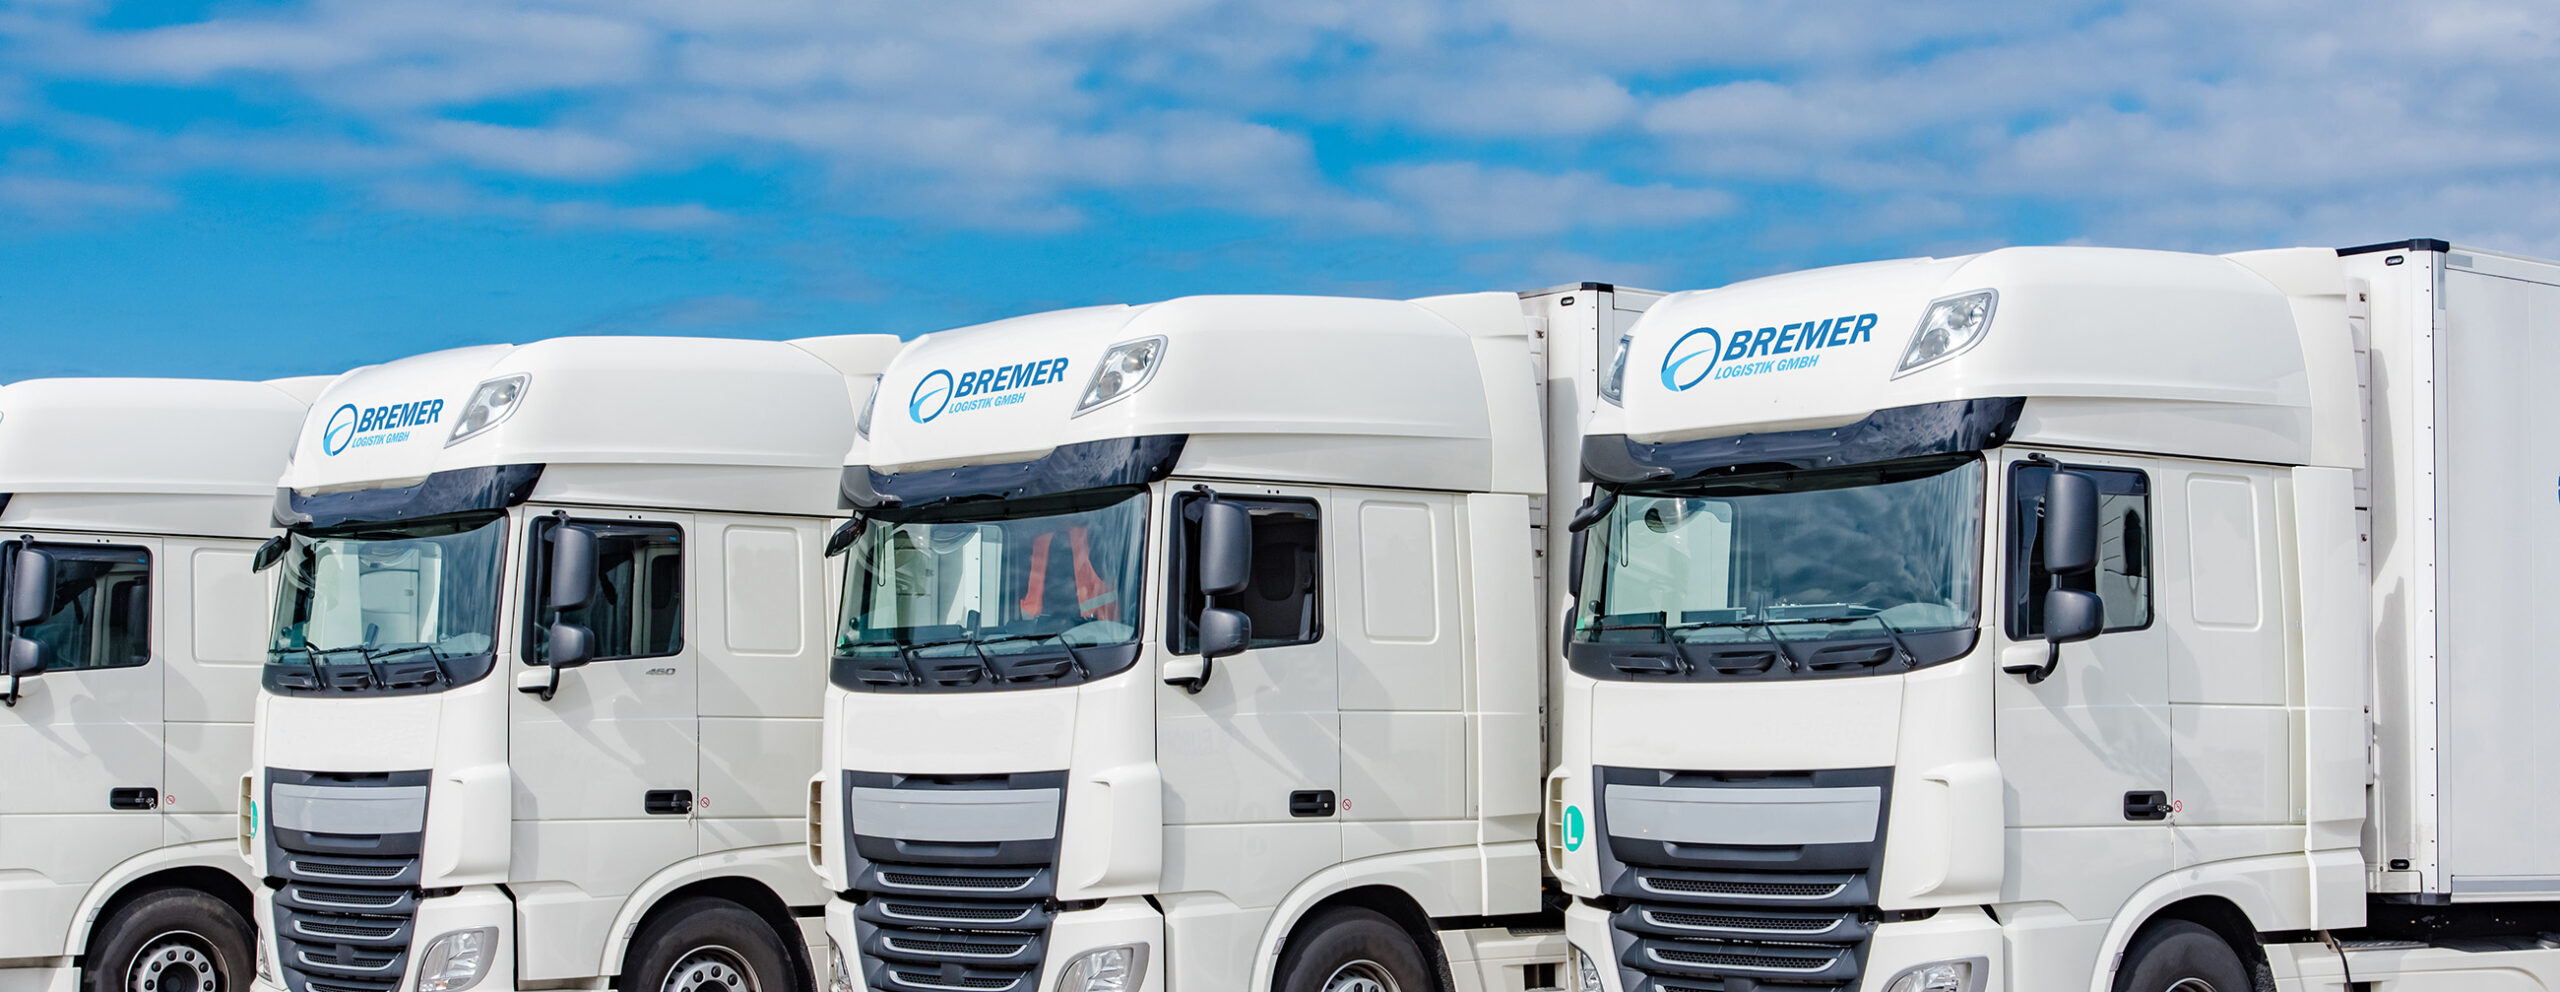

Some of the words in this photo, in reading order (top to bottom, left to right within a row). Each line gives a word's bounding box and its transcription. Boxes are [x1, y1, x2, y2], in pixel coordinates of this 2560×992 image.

[1721, 312, 1878, 362] BREMER
[954, 357, 1069, 398] BREMER
[1714, 360, 1776, 380] LOGISTIK
[1776, 354, 1820, 372] GMBH
[357, 398, 444, 433] BREMER
[948, 397, 994, 414] LOGISTIK
[994, 392, 1026, 407] GMBH
[351, 433, 386, 448] LOGISTIK
[386, 431, 411, 444] GMBH
[1567, 813, 1578, 844] L
